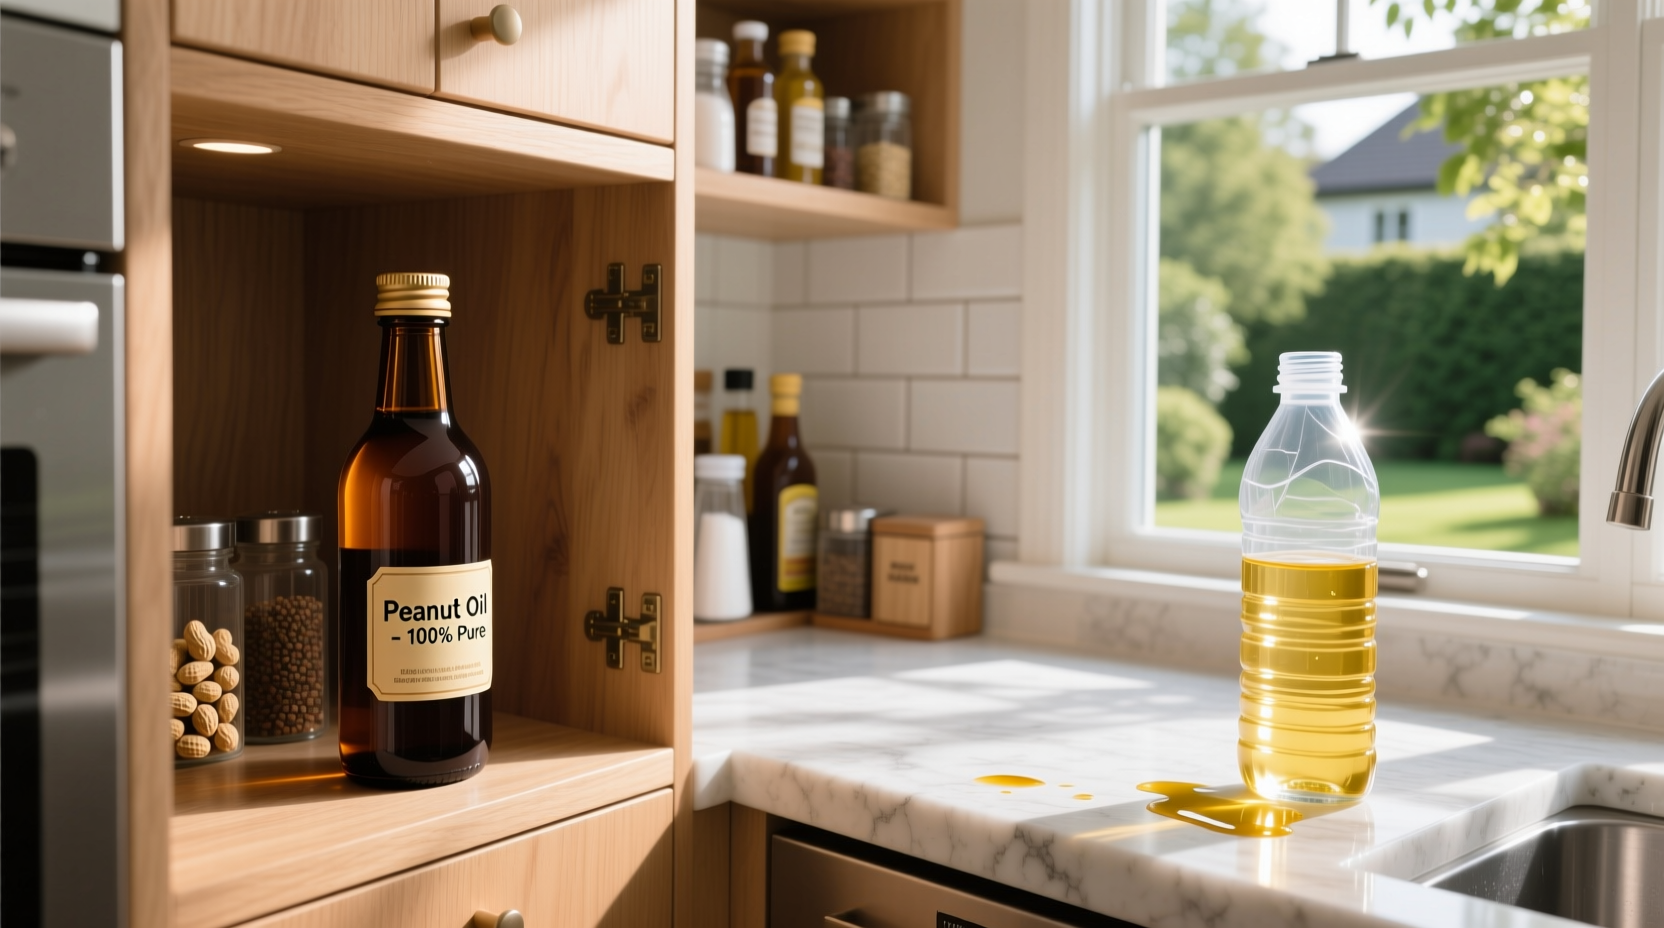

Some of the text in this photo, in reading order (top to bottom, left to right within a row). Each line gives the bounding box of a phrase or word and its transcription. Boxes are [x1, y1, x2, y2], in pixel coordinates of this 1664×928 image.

[384, 592, 487, 622] Peanut Oil
[407, 626, 453, 645] 100%
[457, 625, 486, 641] Pure
